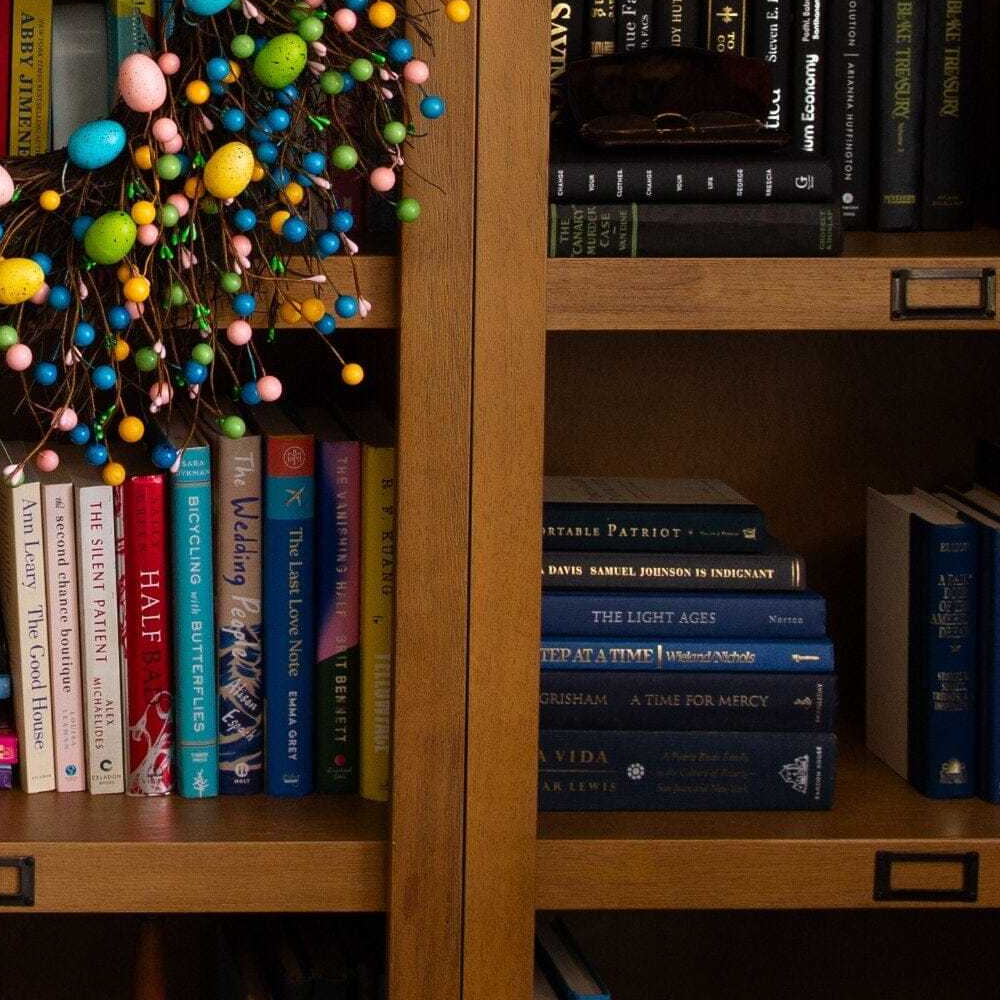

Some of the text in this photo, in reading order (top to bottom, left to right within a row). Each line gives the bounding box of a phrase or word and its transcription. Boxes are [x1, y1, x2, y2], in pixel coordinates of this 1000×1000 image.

[766, 6, 778, 20] E.
[727, 31, 736, 50] TO
[766, 24, 779, 63] Steven
[845, 62, 856, 109] ARIANNA
[843, 114, 854, 181] HUFFINGTON
[560, 217, 570, 245] THE
[586, 205, 598, 255] MURDER
[599, 212, 610, 249] CASE
[221, 451, 262, 659] The Wedding People
[548, 565, 775, 579] DAVIS SAMUEL JOHNSON IS INDIGNANT
[55, 497, 73, 695] the second chance boutique
[90, 501, 108, 664] THE SILENT PATIENT
[22, 499, 48, 750] Ann Leary The Good House
[189, 495, 206, 733] BICYCLING with BUTTERFLIES
[592, 610, 622, 623] THE
[627, 610, 675, 624] LIGHT
[679, 611, 717, 624] AGES
[287, 527, 304, 761] The Last Love Note EMMA GREY
[93, 677, 104, 751] MICHAELIDES
[105, 699, 114, 726] ALEX
[540, 693, 770, 708] GRISHAM A TIME FOR MERCY
